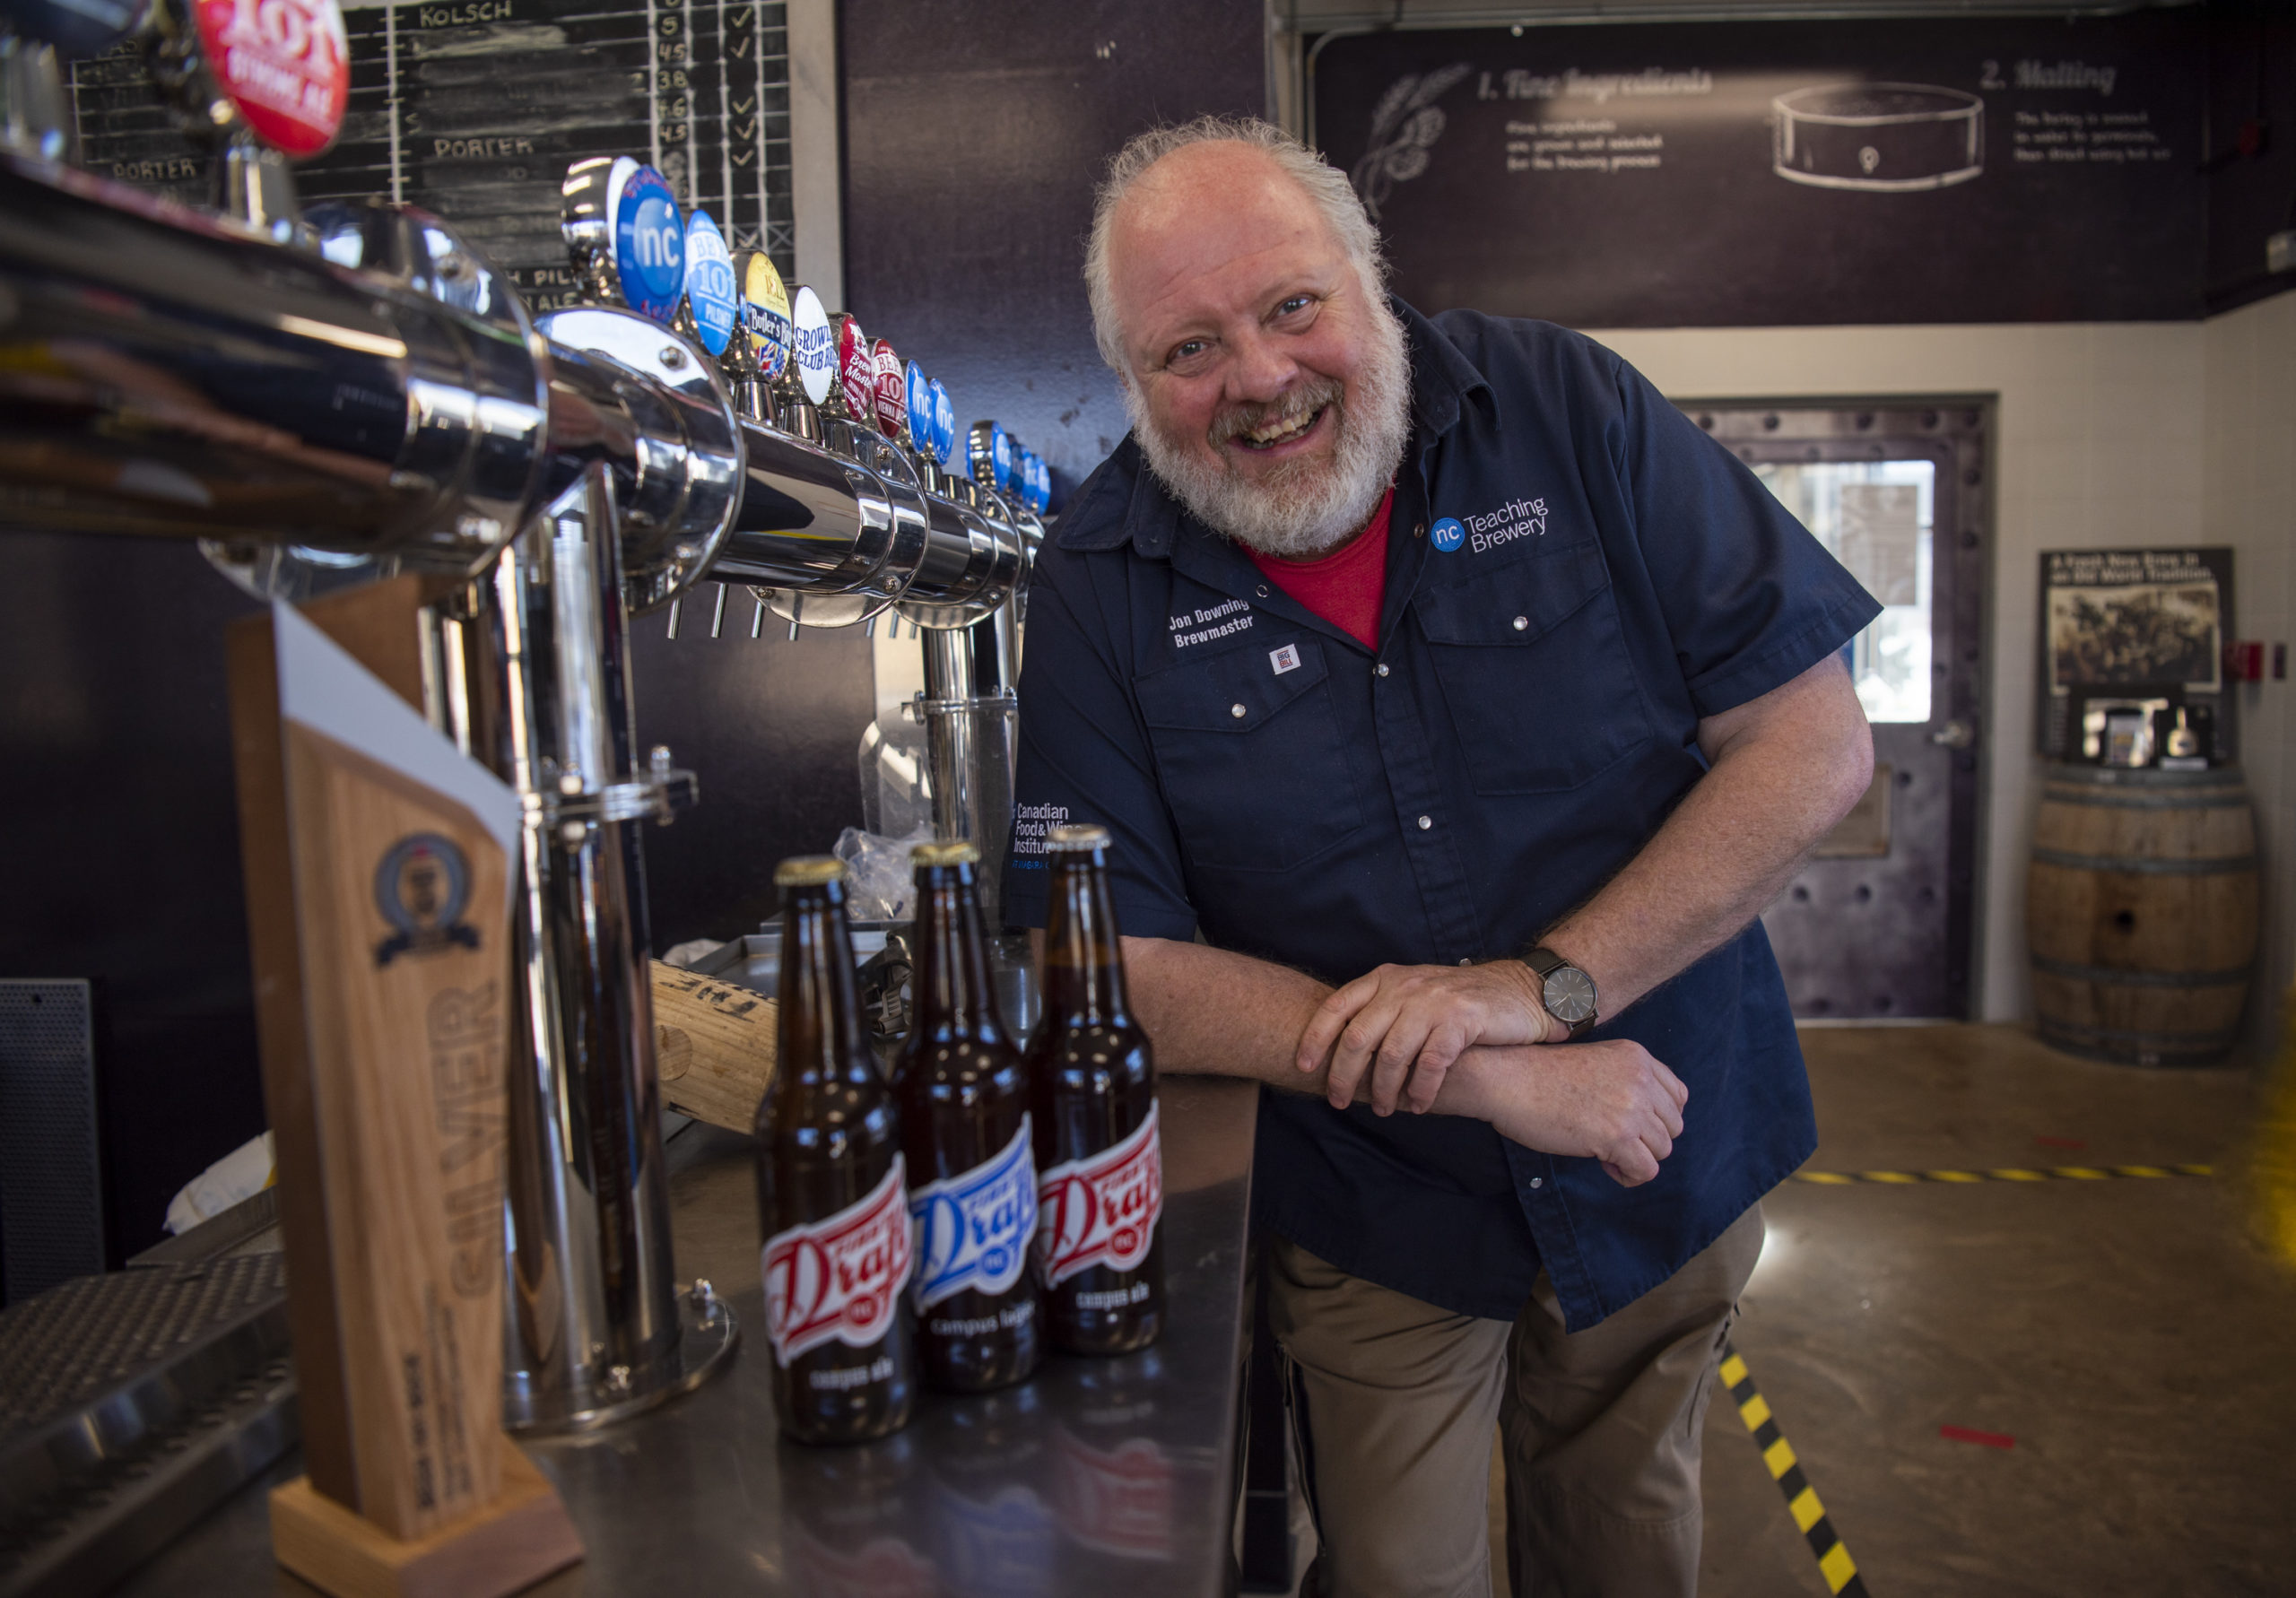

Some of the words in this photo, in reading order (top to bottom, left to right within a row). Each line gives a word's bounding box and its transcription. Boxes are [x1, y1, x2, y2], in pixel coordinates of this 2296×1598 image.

[420, 1, 512, 28] KOLSCH
[661, 16, 679, 36] 5
[434, 138, 535, 158] PORTER
[113, 156, 196, 179] PORTER
[642, 226, 680, 268] nc
[698, 262, 736, 303] 101
[752, 308, 781, 338] Butler's
[797, 350, 824, 371] CLUB
[845, 365, 873, 389] Maste
[917, 392, 931, 420] nc
[940, 408, 954, 435] nc
[1464, 498, 1549, 534] Teaching
[1436, 525, 1459, 544] nc
[1471, 517, 1546, 553] Brewery
[1169, 616, 1192, 631] Jon
[1195, 598, 1250, 624] Downing
[1174, 615, 1254, 648] Brewmaster
[1277, 652, 1291, 662] BIG
[1279, 659, 1292, 669] BILL
[1017, 803, 1069, 820] Canadian
[1015, 820, 1038, 837] Food
[427, 981, 504, 1298] SILVER
[931, 1314, 998, 1337] campus
